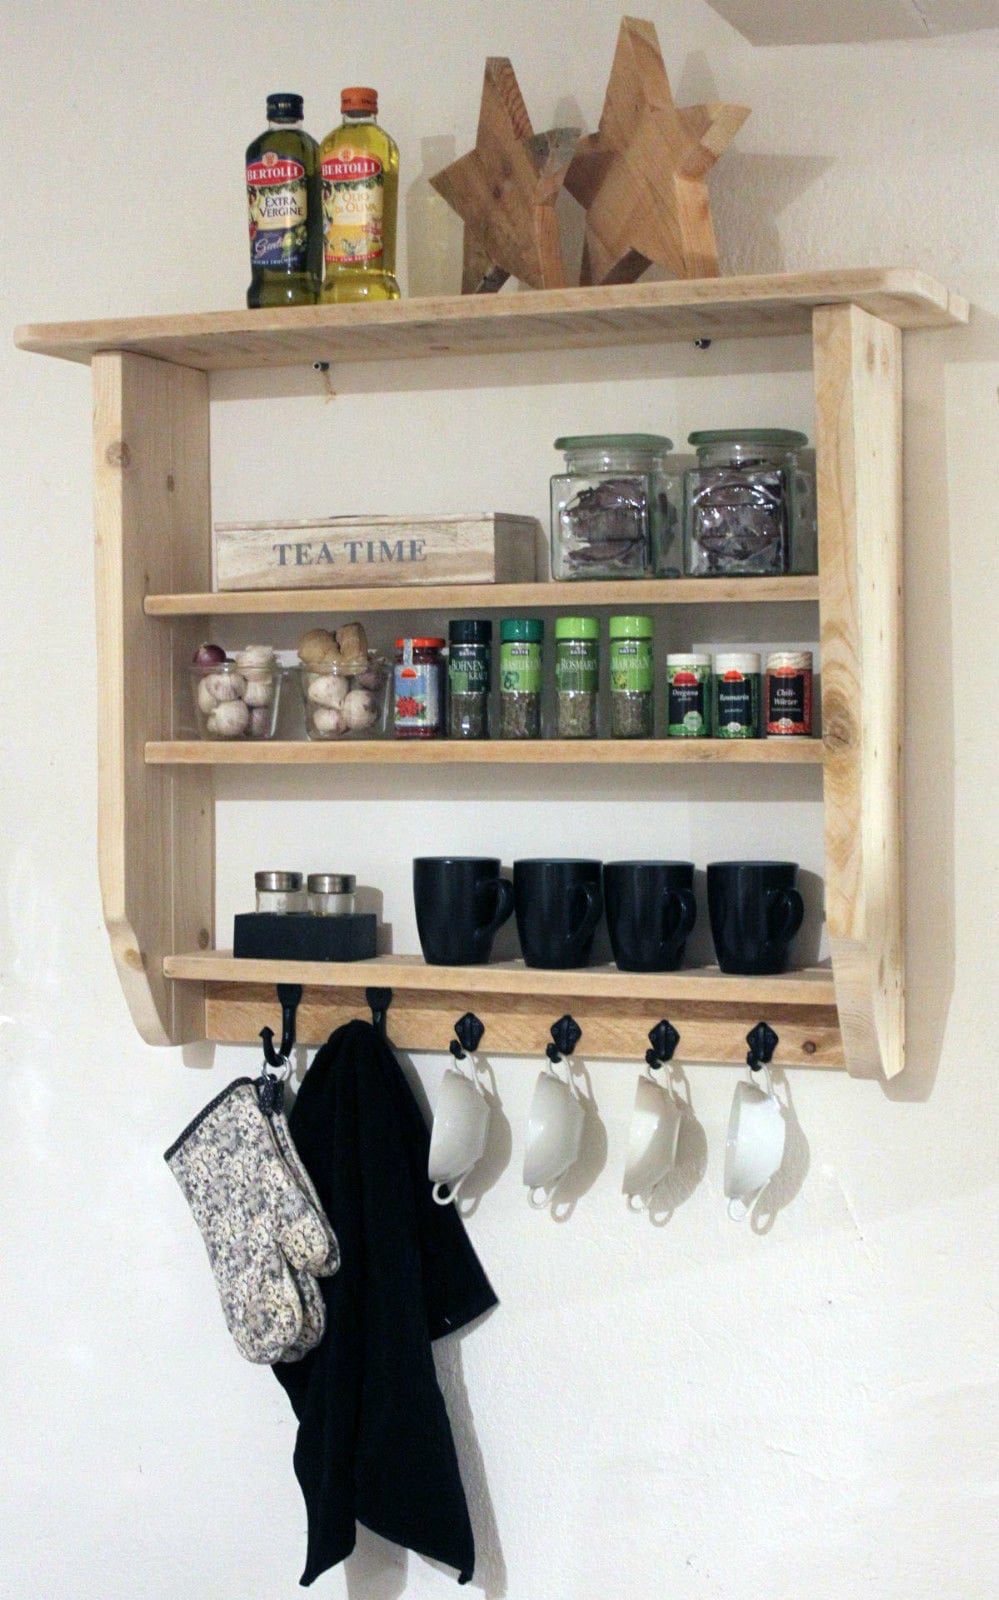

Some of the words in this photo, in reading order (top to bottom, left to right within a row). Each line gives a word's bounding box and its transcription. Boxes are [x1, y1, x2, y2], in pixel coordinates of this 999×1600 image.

[247, 166, 298, 181] BERTOLLI
[321, 162, 375, 177] BERTOLLI
[265, 197, 297, 207] EXTRA
[259, 207, 304, 218] VERGINE
[273, 543, 334, 566] TEA
[344, 539, 427, 564] TIME
